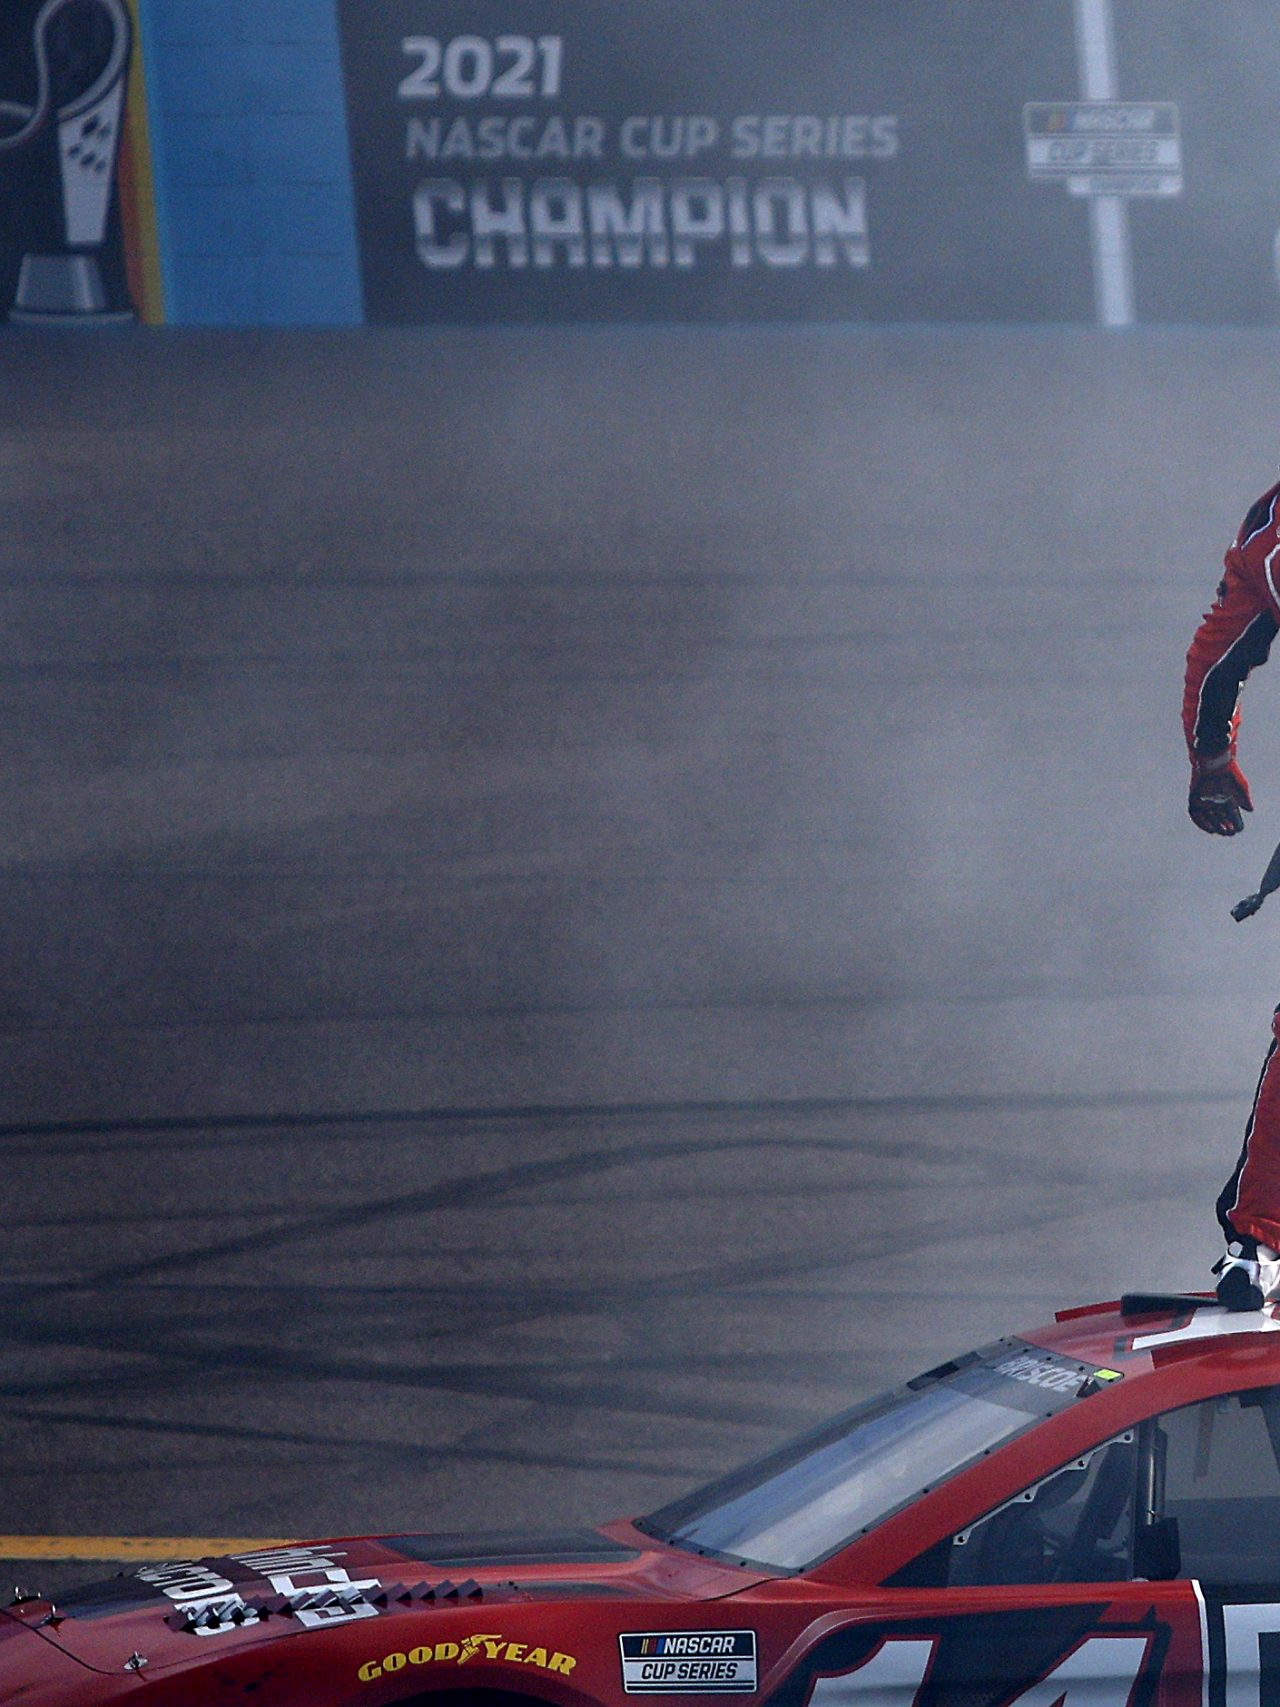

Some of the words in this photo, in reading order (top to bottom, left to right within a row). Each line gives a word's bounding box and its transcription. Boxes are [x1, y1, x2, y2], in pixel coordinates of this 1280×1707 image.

[399, 34, 563, 97] 2021
[406, 116, 604, 158] NASCAR
[620, 116, 718, 158] CUP
[731, 115, 898, 157] SERIES
[413, 176, 871, 268] CHAMPION
[663, 1636, 735, 1654] NASCAR
[641, 1662, 676, 1680] CUP
[677, 1662, 739, 1680] SERIES
